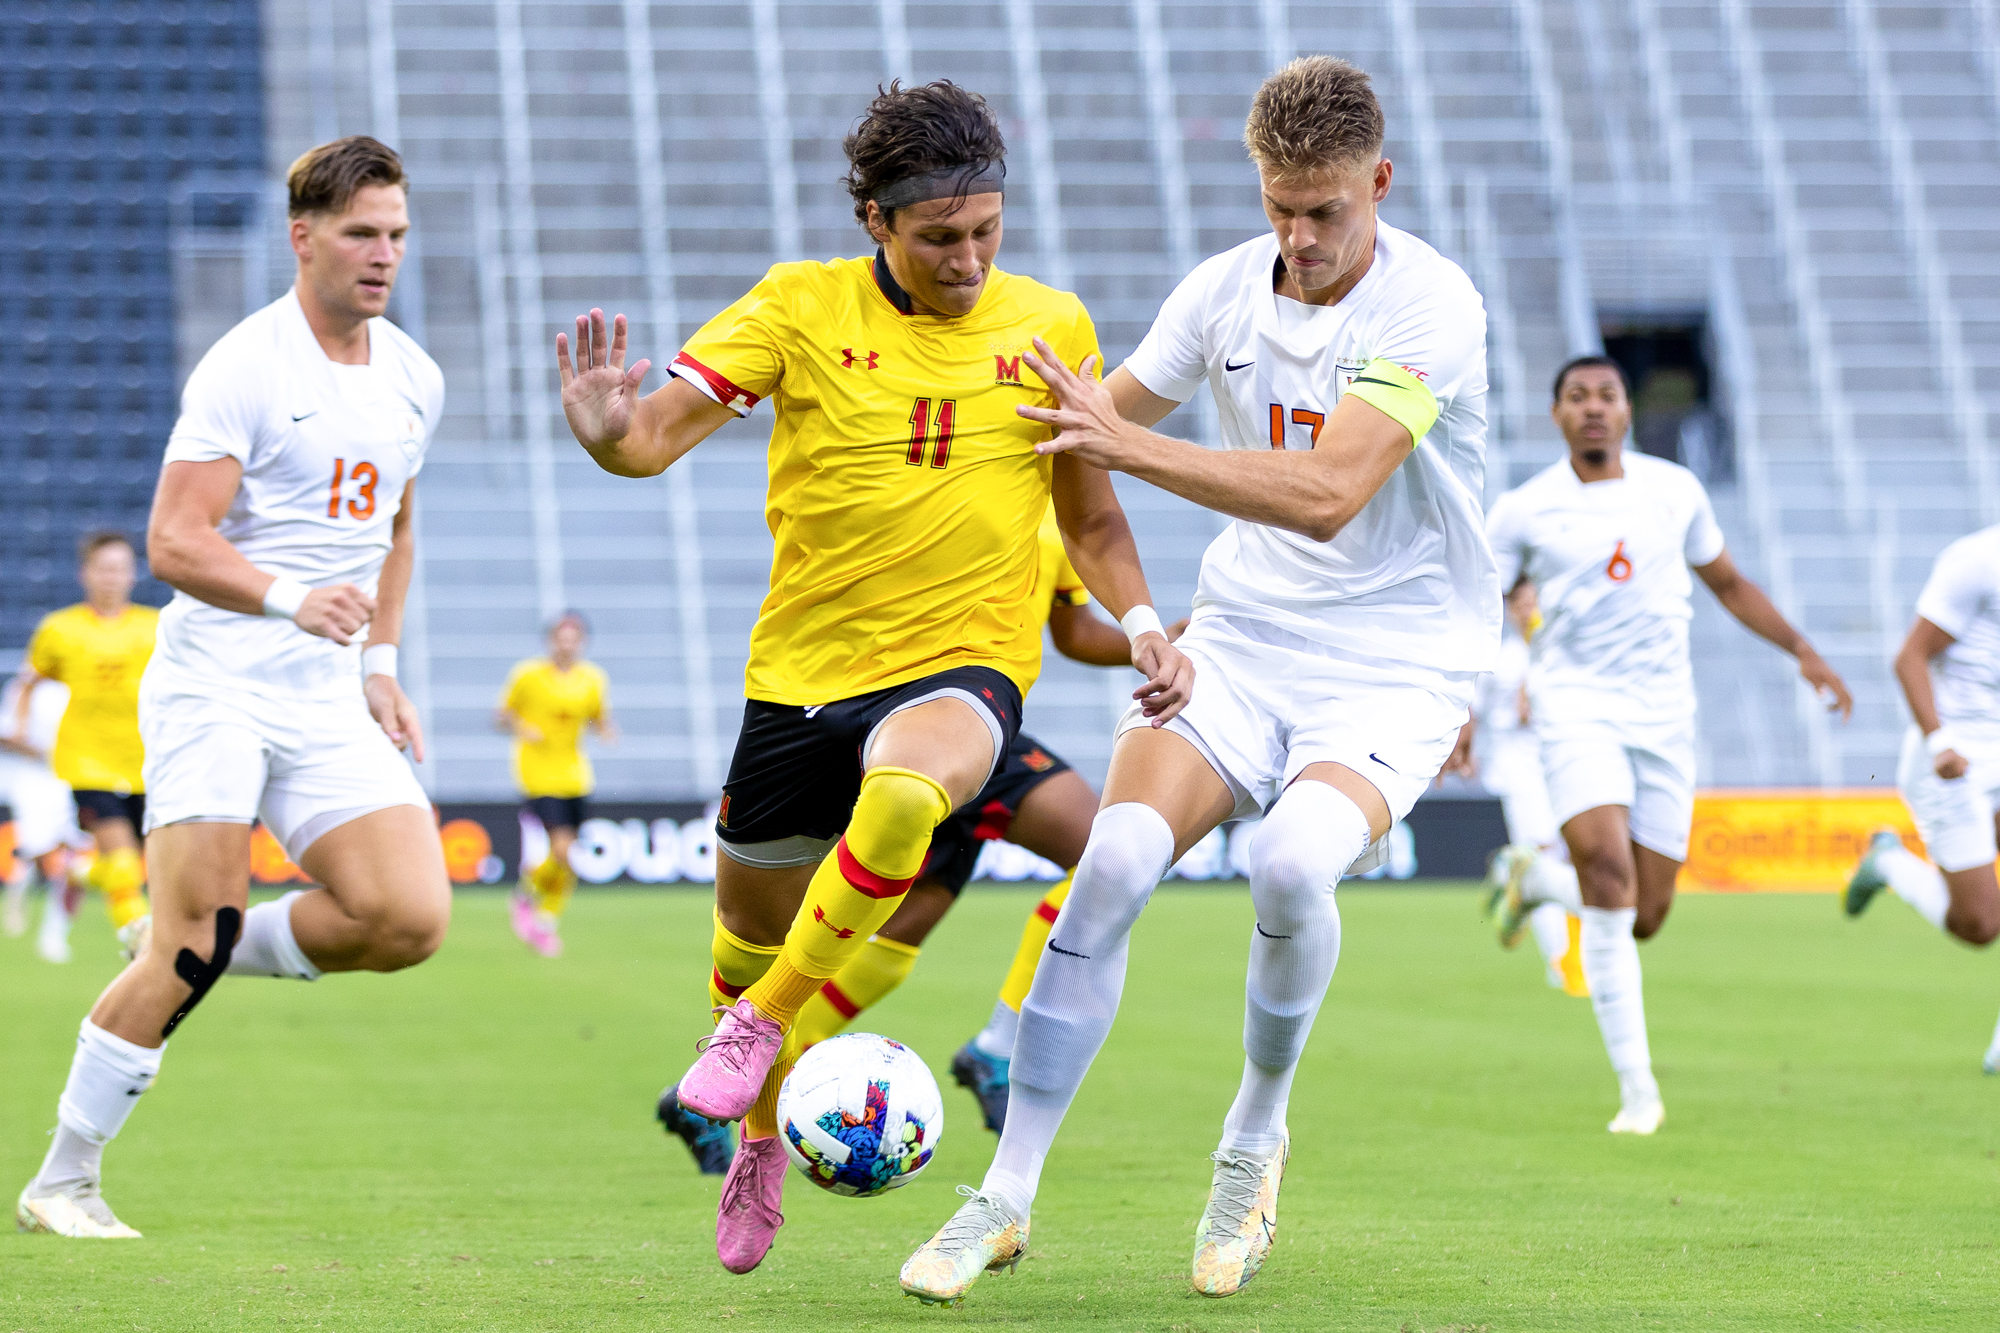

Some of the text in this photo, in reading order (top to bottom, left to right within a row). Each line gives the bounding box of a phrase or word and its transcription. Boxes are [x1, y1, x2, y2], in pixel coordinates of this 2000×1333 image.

[994, 354, 1022, 382] M
[906, 397, 956, 469] 11
[1269, 403, 1325, 450] 17
[327, 458, 379, 521] 13
[1606, 541, 1633, 583] 6
